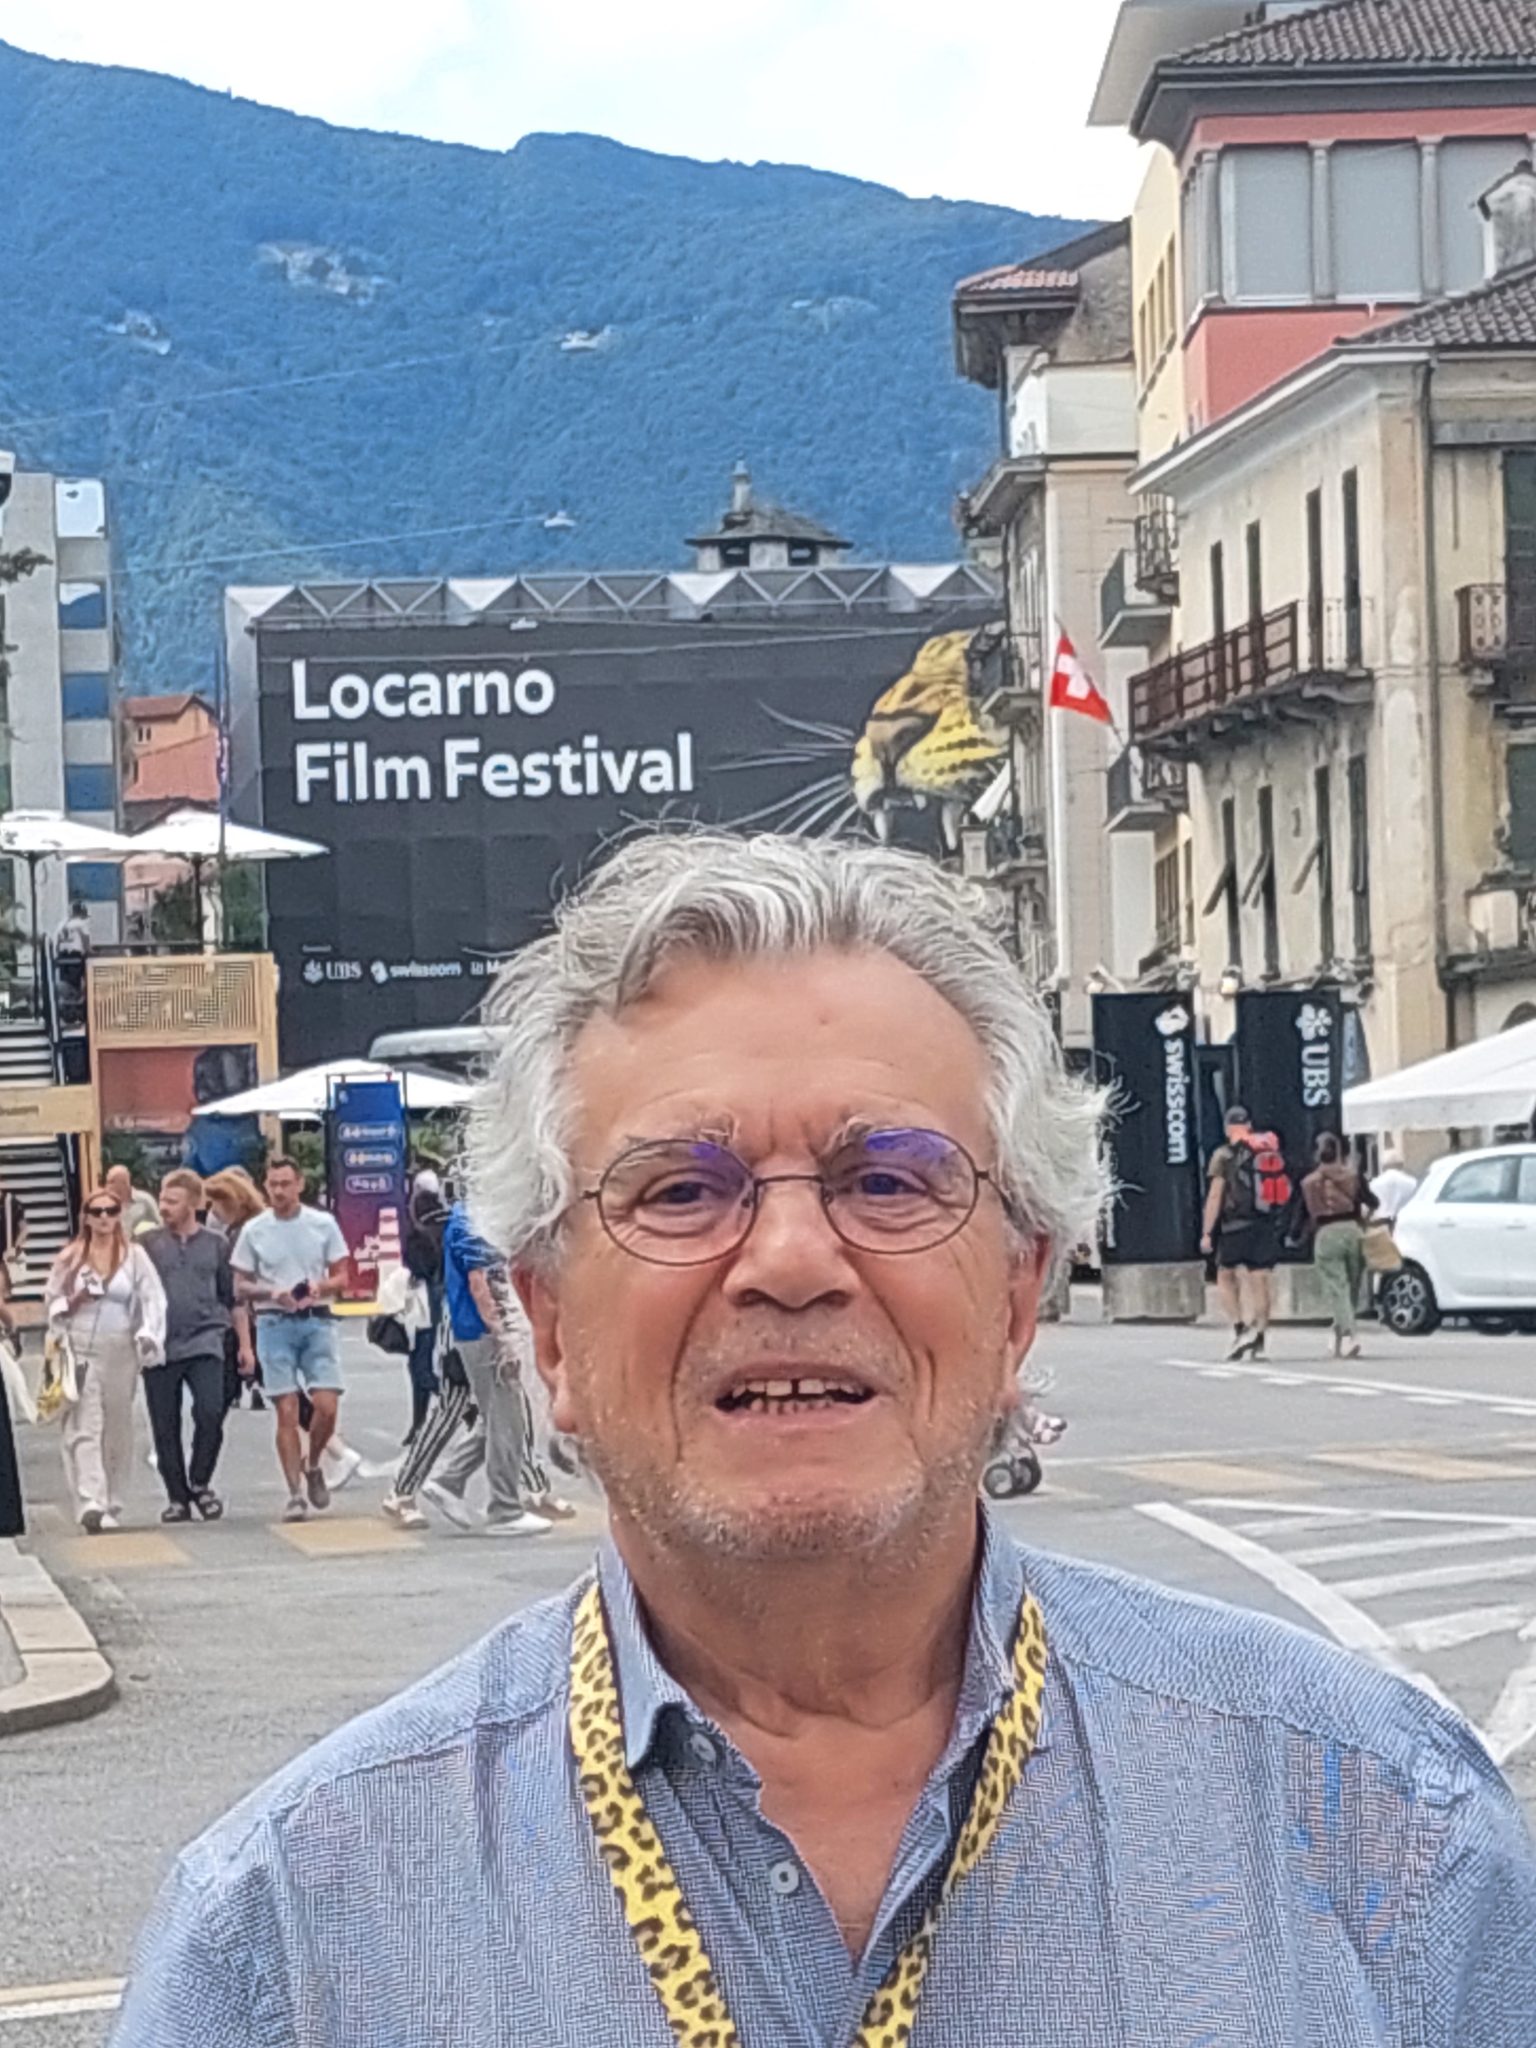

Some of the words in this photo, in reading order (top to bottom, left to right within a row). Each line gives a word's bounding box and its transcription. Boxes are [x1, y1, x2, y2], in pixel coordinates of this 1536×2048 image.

[292, 659, 555, 720] Locarno
[295, 741, 431, 802] Film
[443, 731, 694, 799] Festival
[1163, 1037, 1190, 1165] swisscom
[1301, 1043, 1332, 1108] UBS
